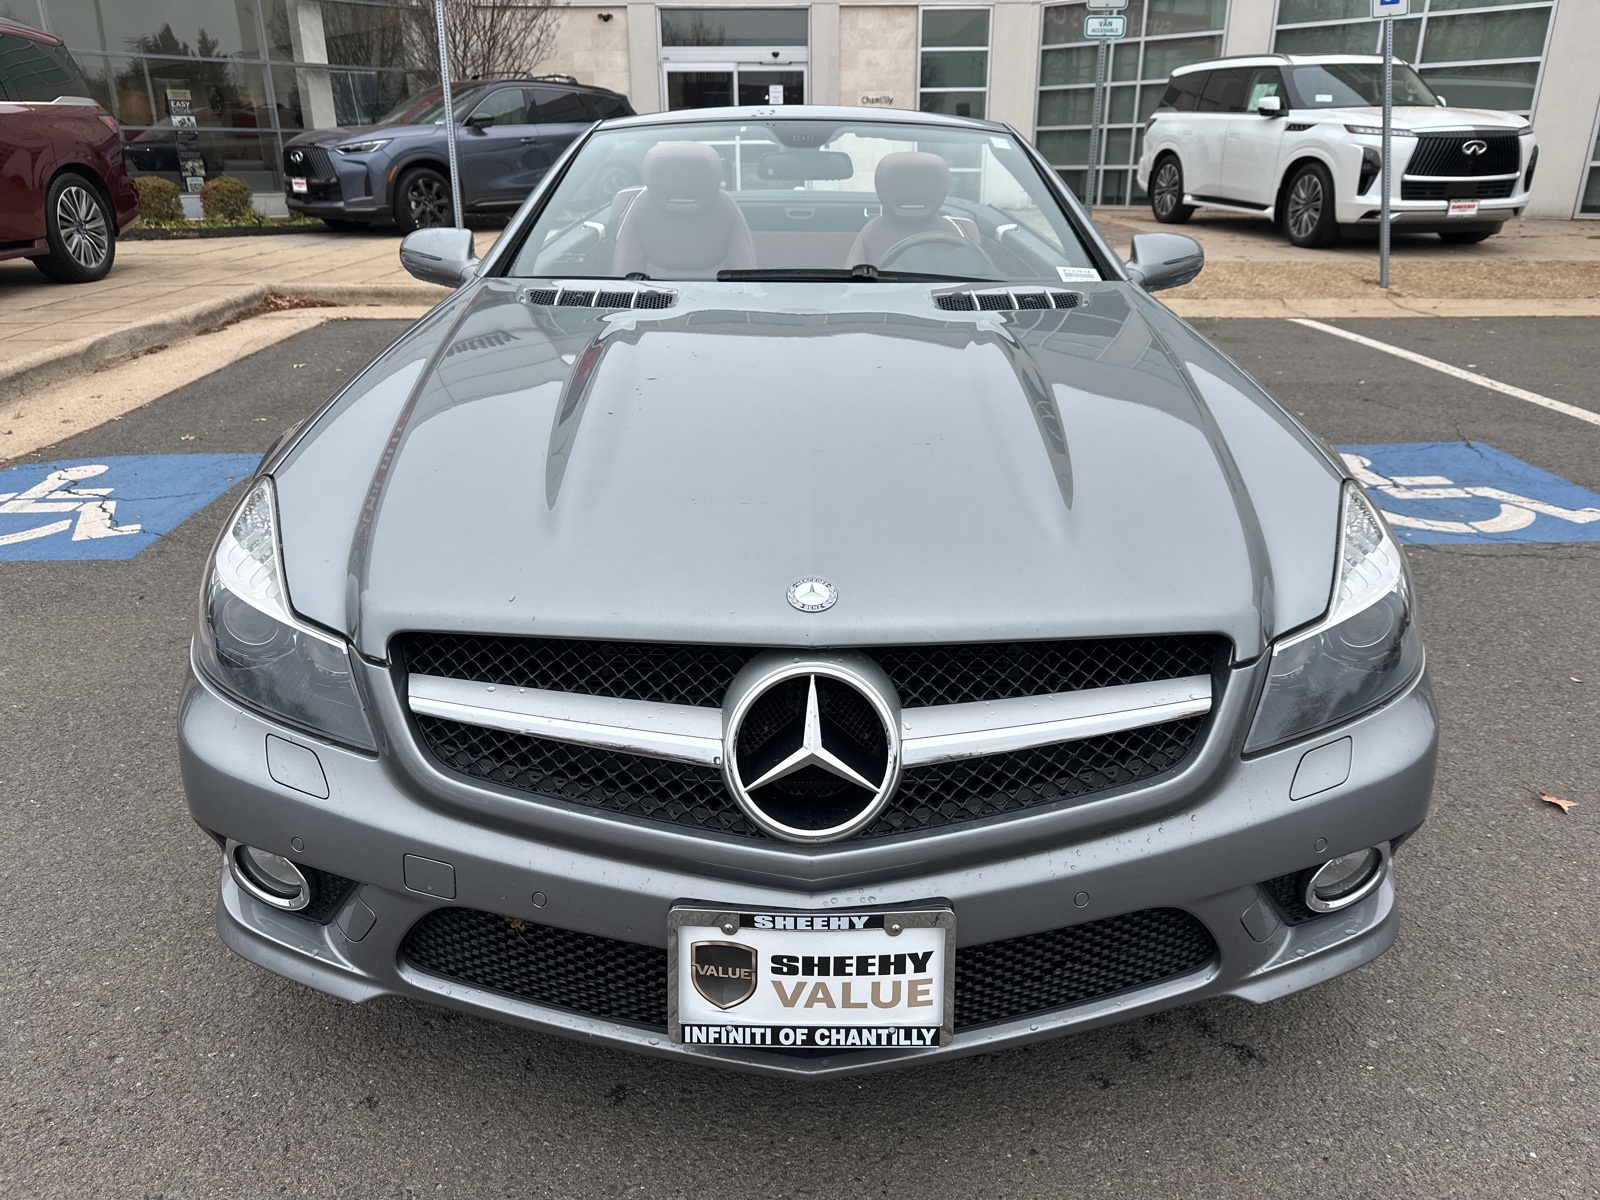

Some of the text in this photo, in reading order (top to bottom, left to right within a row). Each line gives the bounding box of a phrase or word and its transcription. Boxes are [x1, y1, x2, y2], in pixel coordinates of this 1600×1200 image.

[753, 915, 870, 930] SHEEHY
[697, 964, 752, 980] VALUE
[770, 951, 935, 977] SHEEHY
[770, 978, 934, 1009] VALUE
[684, 1026, 936, 1046] INFINITI OF CHANTILLY
